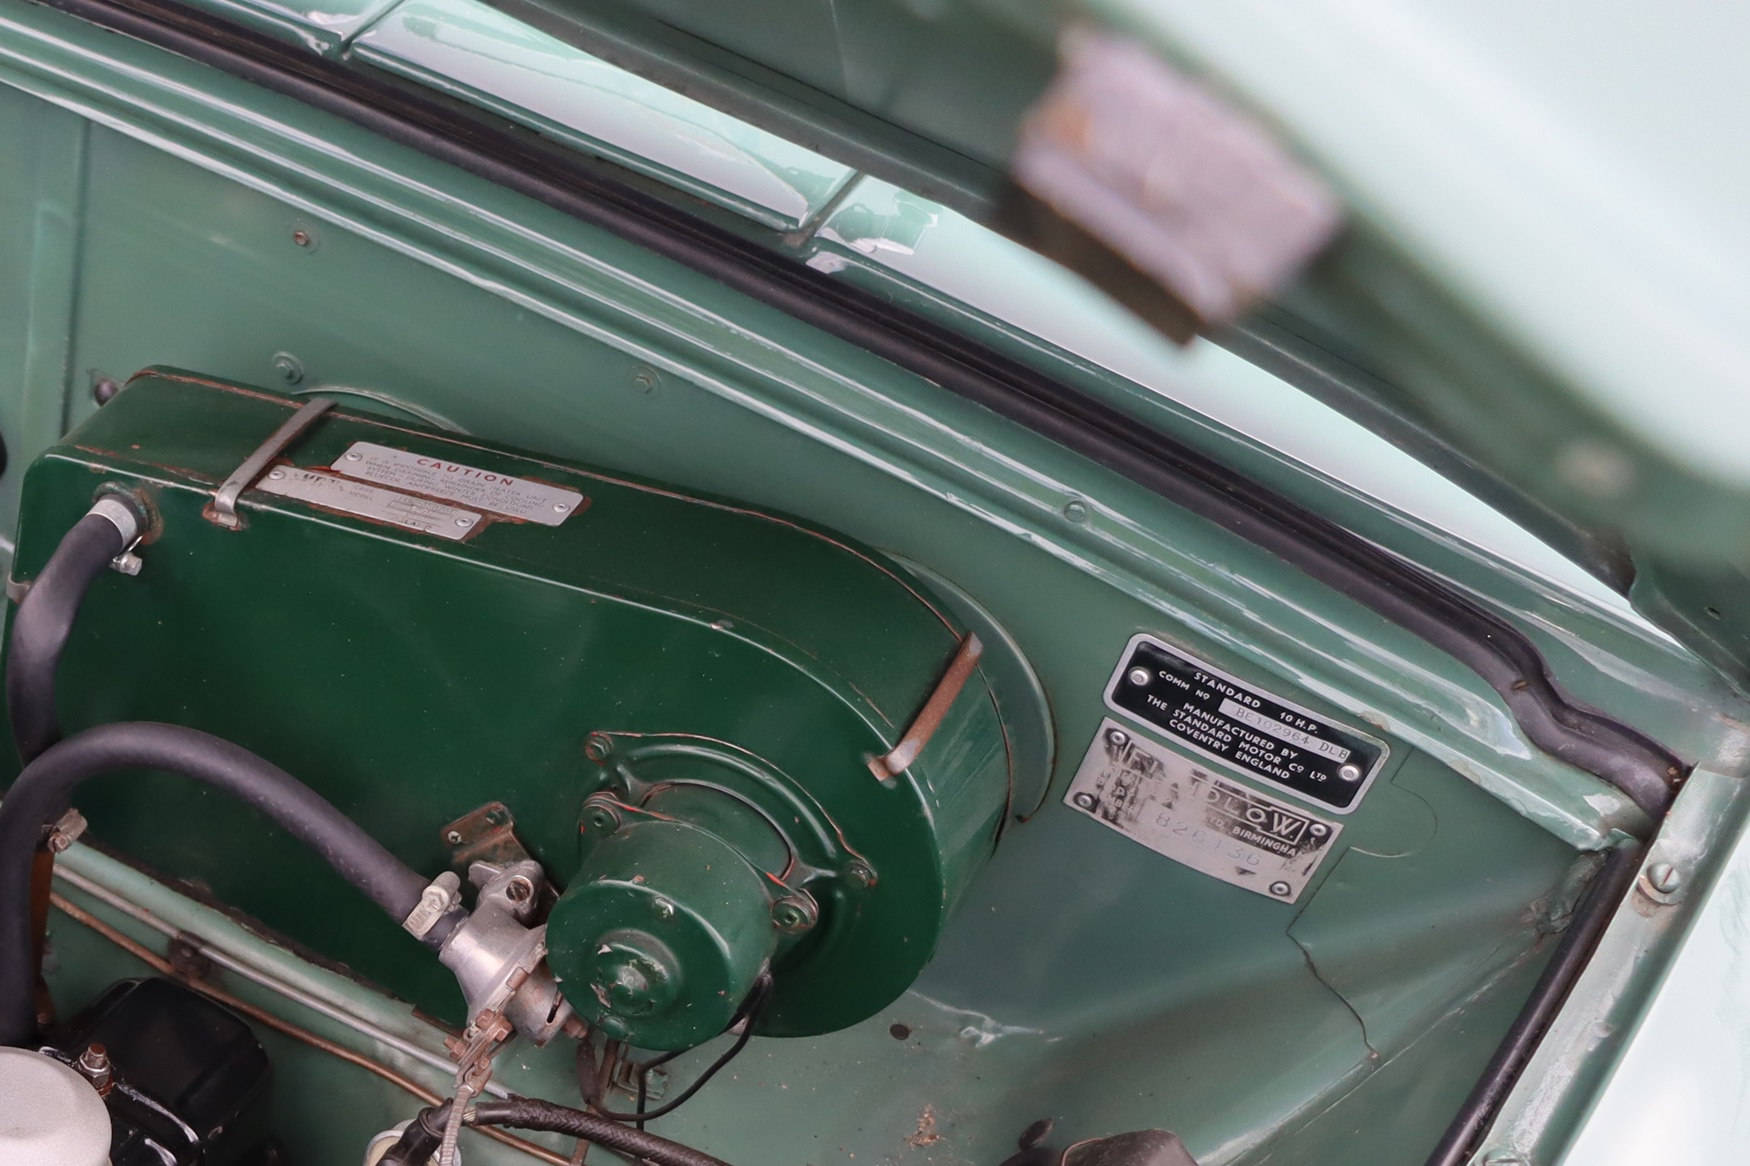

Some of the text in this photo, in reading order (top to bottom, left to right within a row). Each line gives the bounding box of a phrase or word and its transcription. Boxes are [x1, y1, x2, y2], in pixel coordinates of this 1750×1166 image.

[365, 460, 390, 470] WHEN
[504, 494, 545, 508] COOLING
[416, 458, 514, 486] CAUTION
[458, 477, 485, 488] DRAIN
[489, 485, 522, 497] HEATER
[526, 494, 548, 503] UNIT
[1146, 694, 1168, 711] THE
[1172, 708, 1232, 744] STANDARD
[1238, 741, 1282, 765] MOTOR
[1158, 670, 1191, 690] COMM
[1235, 706, 1311, 746] BE102964
[1182, 702, 1298, 761] MANUFACTURED BY
[1194, 672, 1318, 735] STANDARD 10 H.P.
[1168, 718, 1291, 780] COVENTRY ENGLAND
